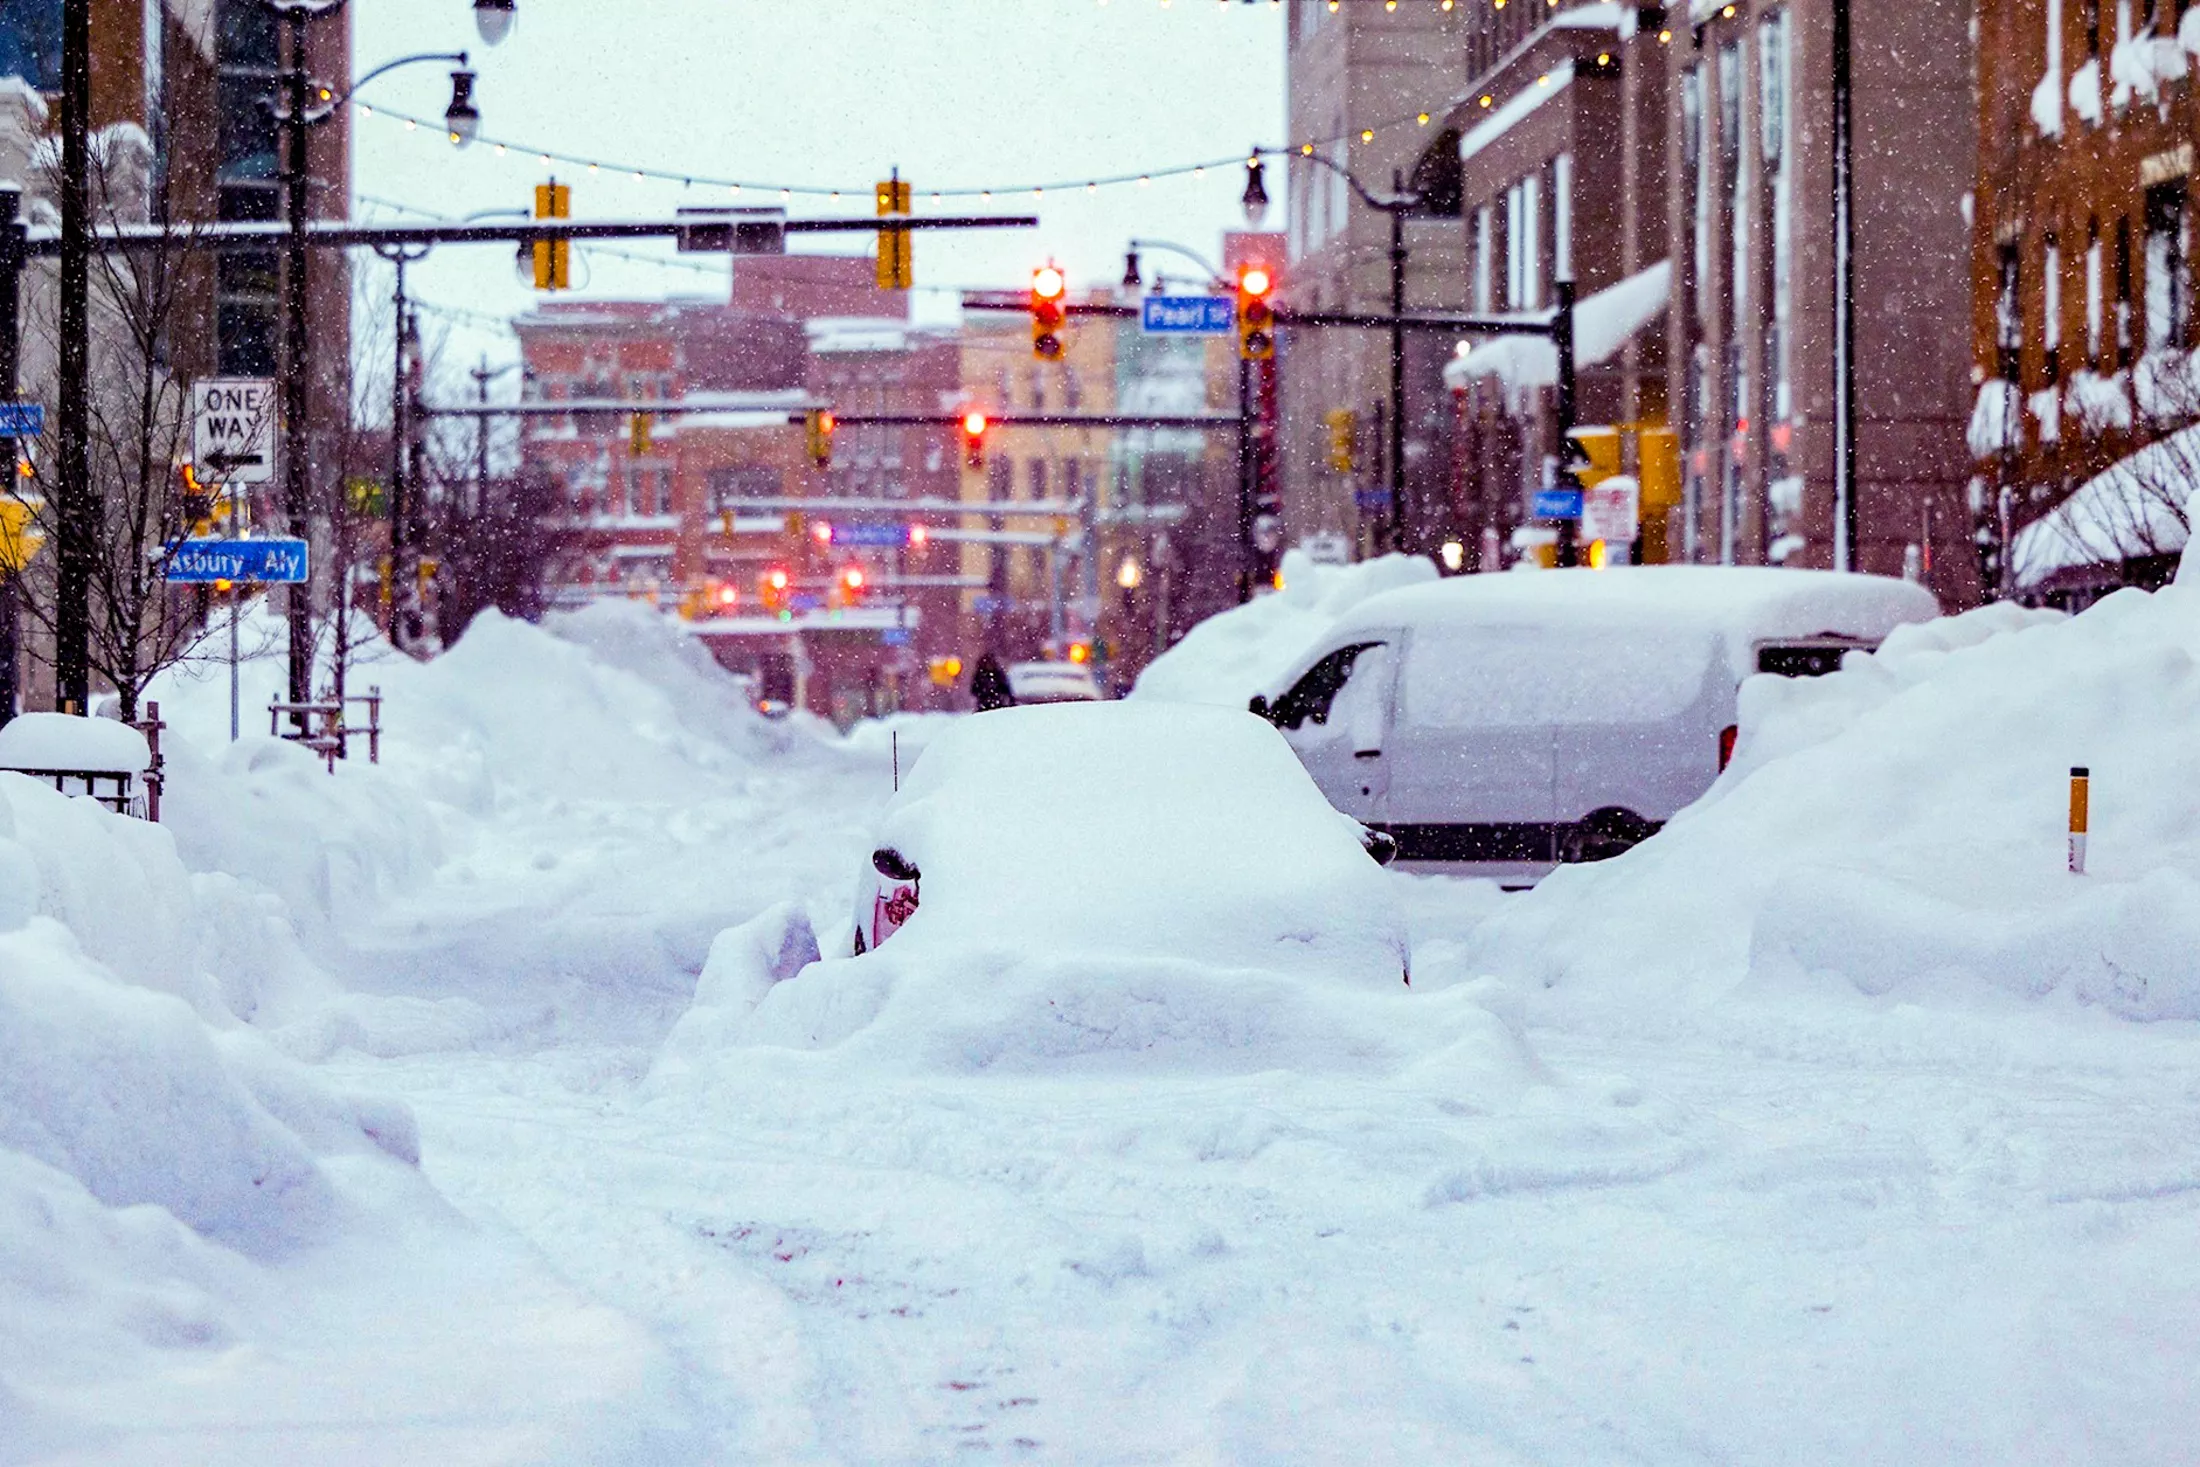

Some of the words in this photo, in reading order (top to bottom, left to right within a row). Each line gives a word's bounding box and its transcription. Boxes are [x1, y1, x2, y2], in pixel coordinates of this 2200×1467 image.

[1148, 303, 1205, 326] Pearl
[208, 389, 258, 410] ONE
[208, 417, 259, 438] WAY
[169, 551, 244, 577] Asbury
[264, 550, 301, 579] Aly
